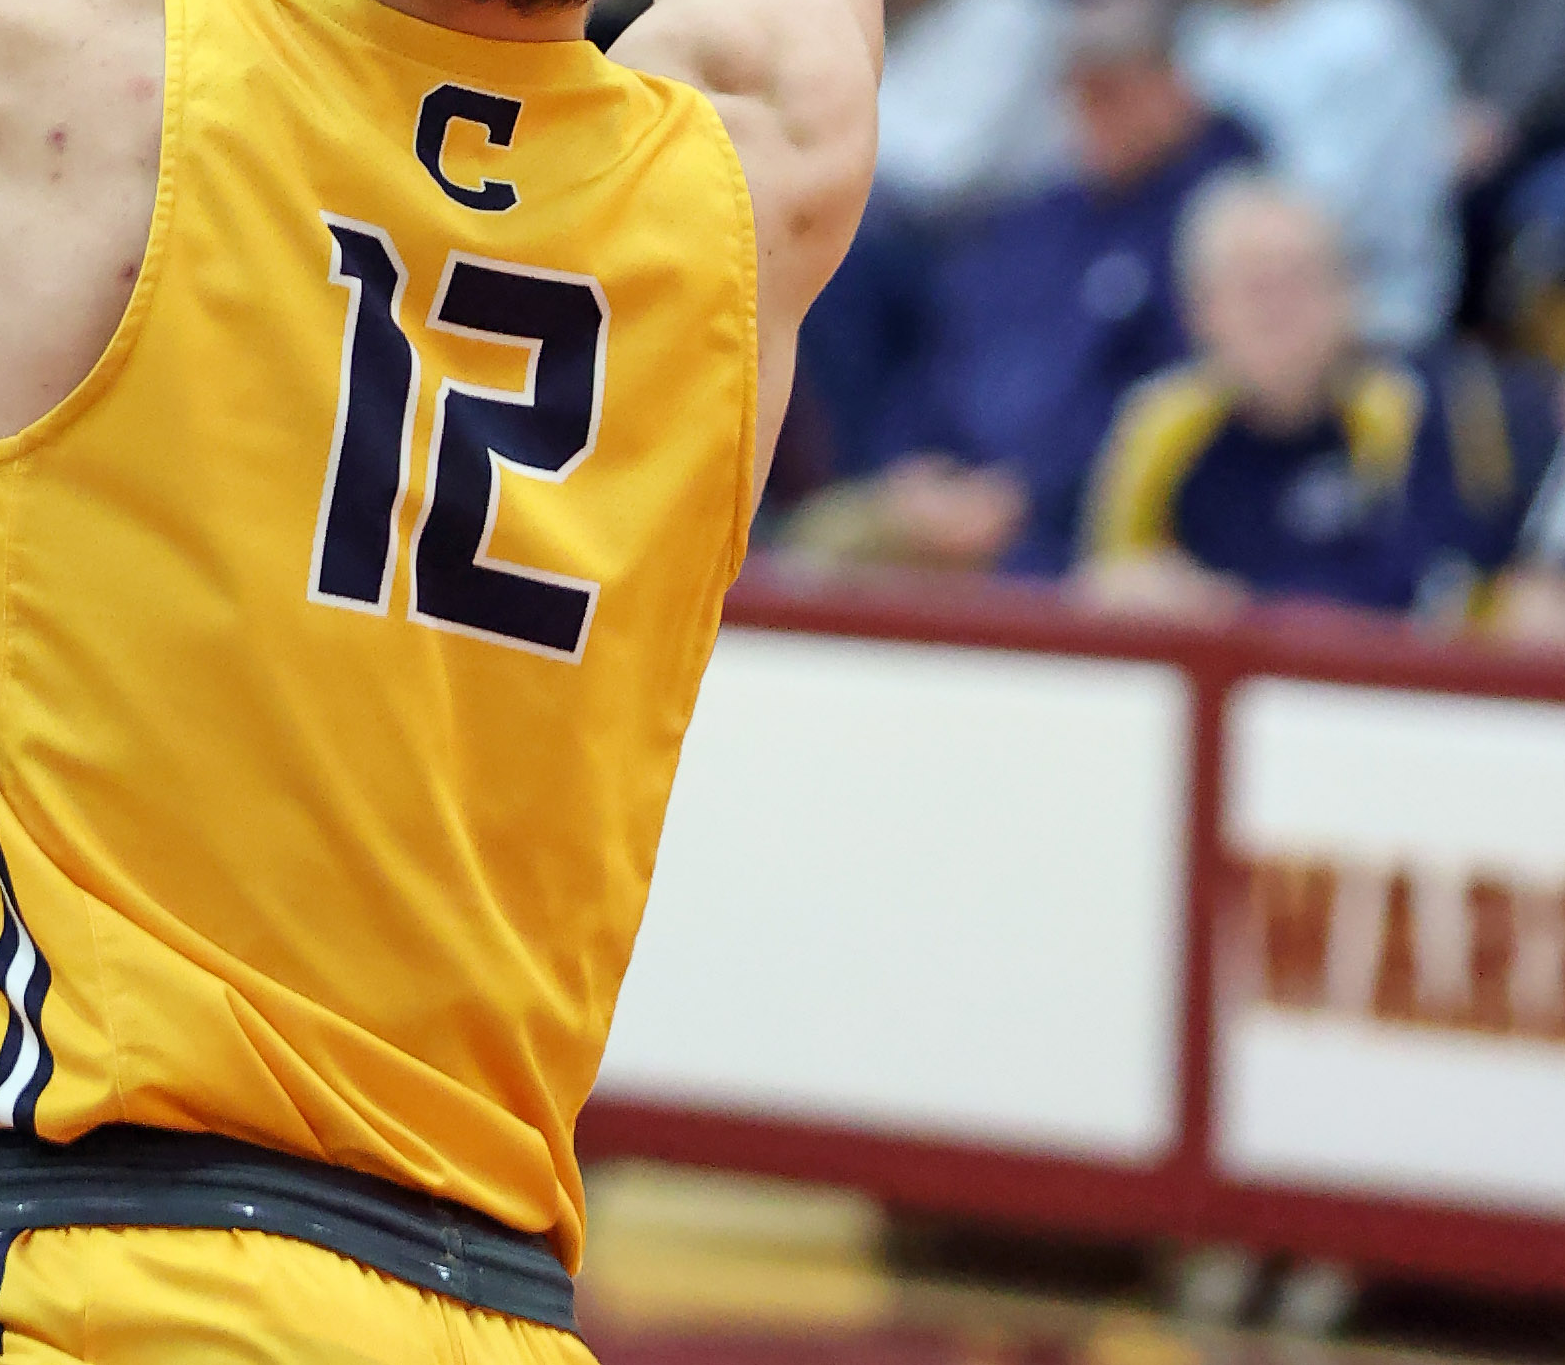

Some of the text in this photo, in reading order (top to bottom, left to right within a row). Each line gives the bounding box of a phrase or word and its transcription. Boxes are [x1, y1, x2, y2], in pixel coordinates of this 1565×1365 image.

[414, 81, 524, 213] C
[306, 208, 612, 666] 12
[1237, 855, 1565, 1043] WAR
